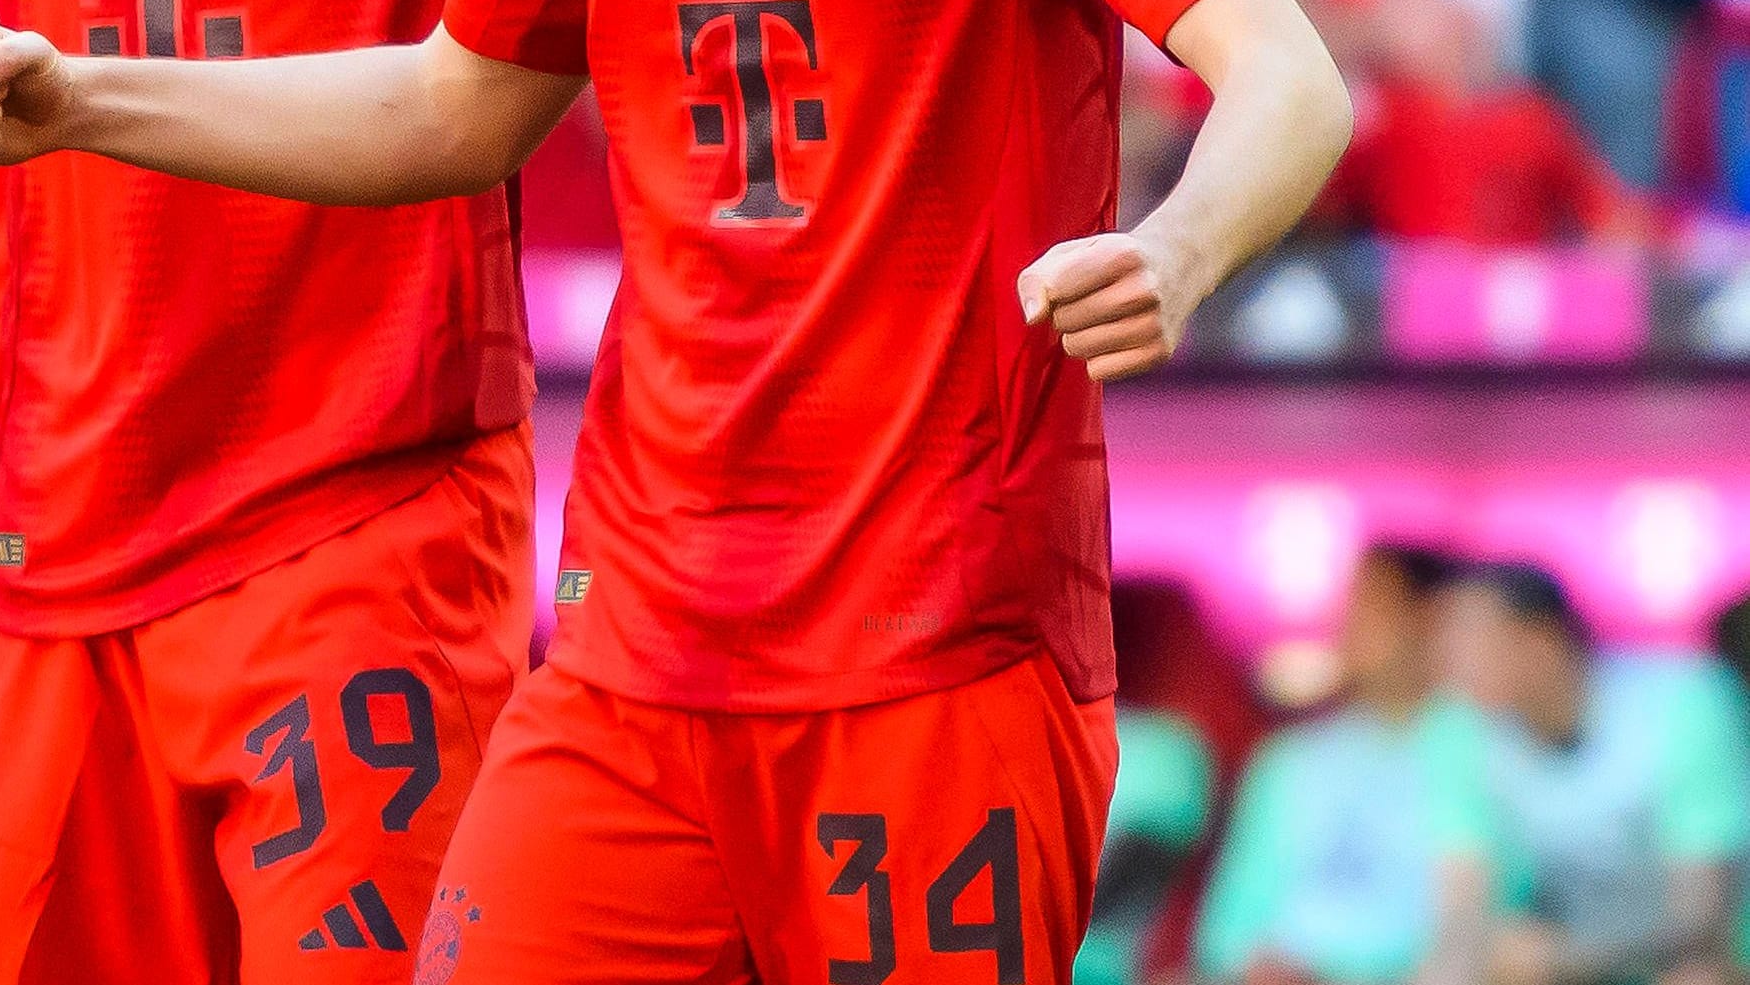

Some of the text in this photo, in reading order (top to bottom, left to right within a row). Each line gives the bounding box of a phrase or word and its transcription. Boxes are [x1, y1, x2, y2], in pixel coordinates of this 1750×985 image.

[677, 0, 828, 219] T
[245, 667, 442, 870] 39
[816, 806, 1026, 985] 34
